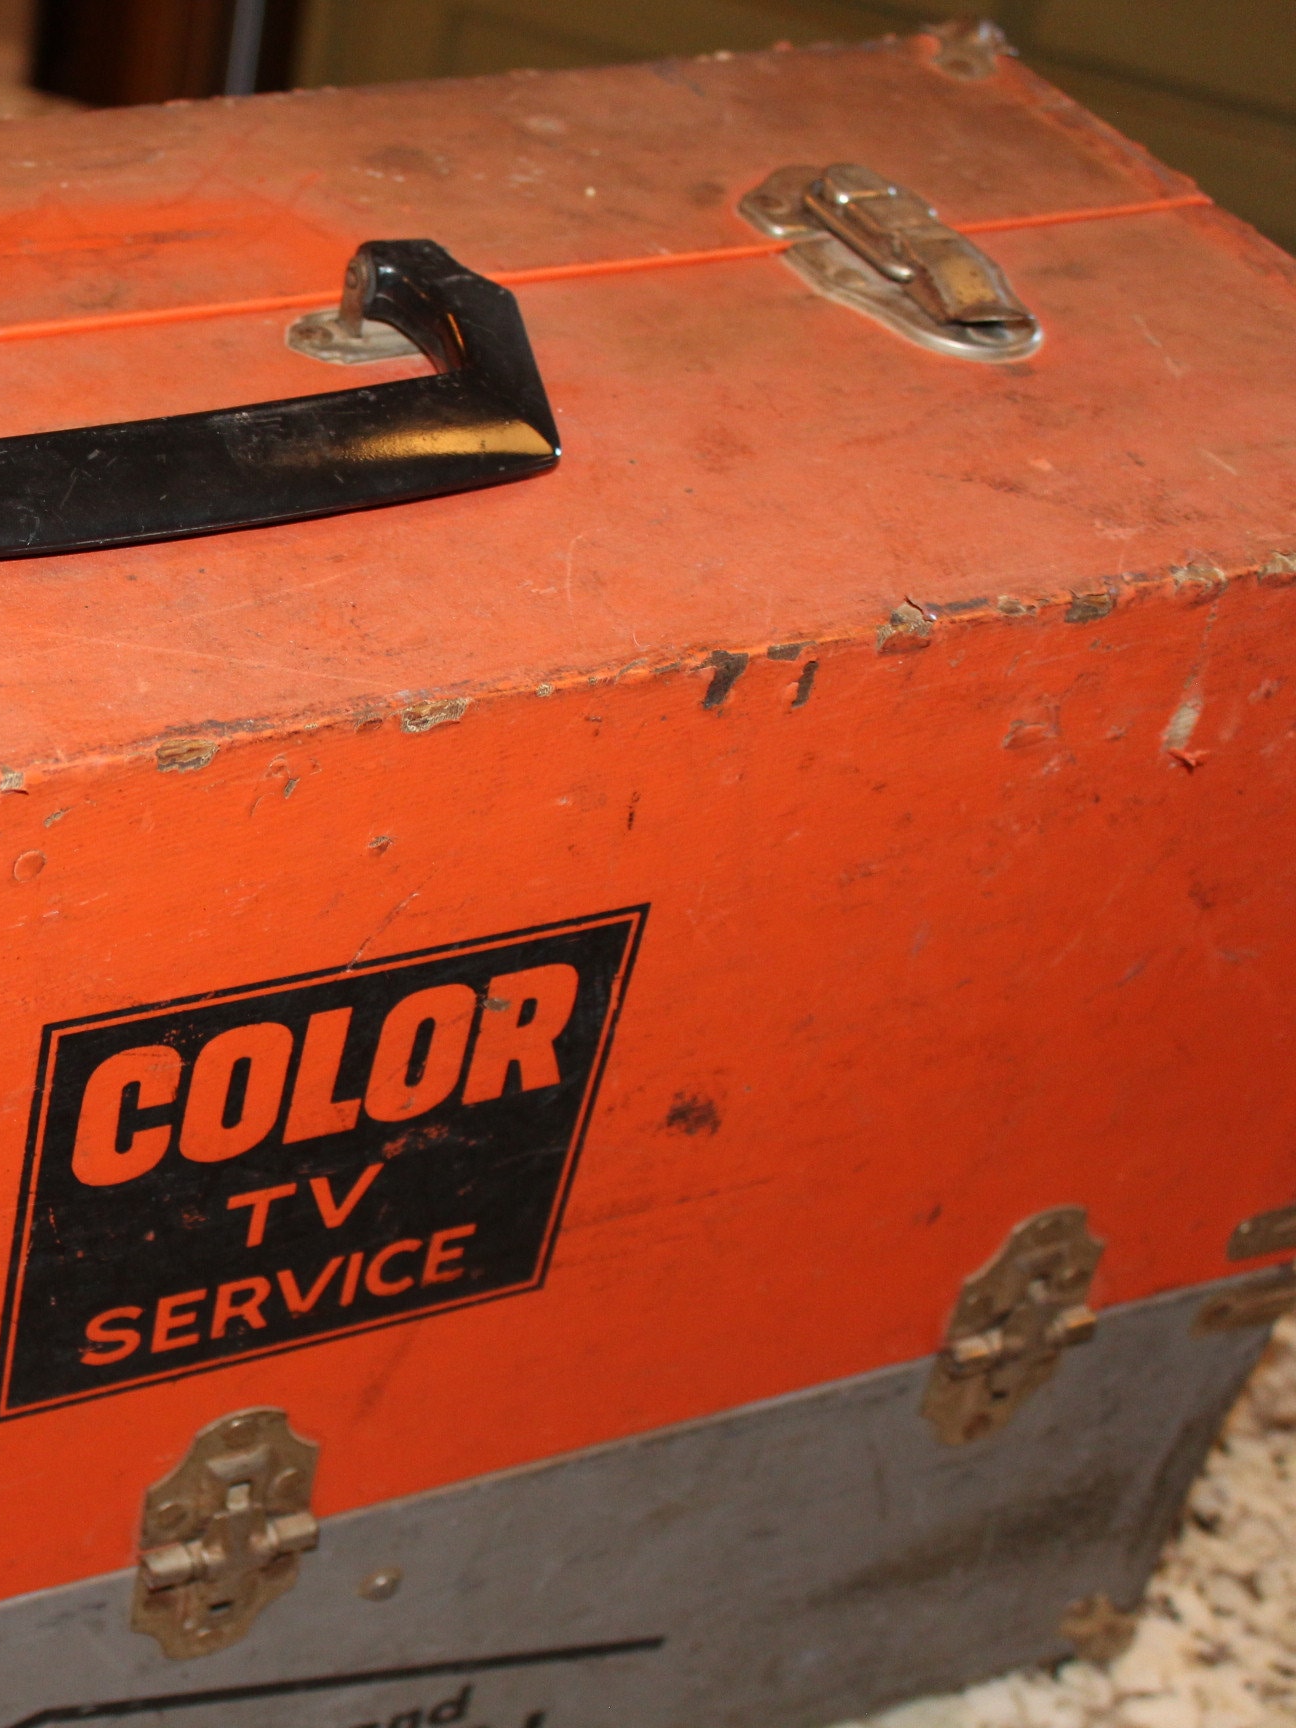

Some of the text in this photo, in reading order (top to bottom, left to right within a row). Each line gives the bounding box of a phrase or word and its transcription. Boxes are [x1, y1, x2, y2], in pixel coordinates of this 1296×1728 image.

[71, 964, 579, 1187] COLOR
[227, 1164, 385, 1249] TV
[81, 1224, 477, 1366] SERVICE
[350, 1684, 473, 1728] nd
